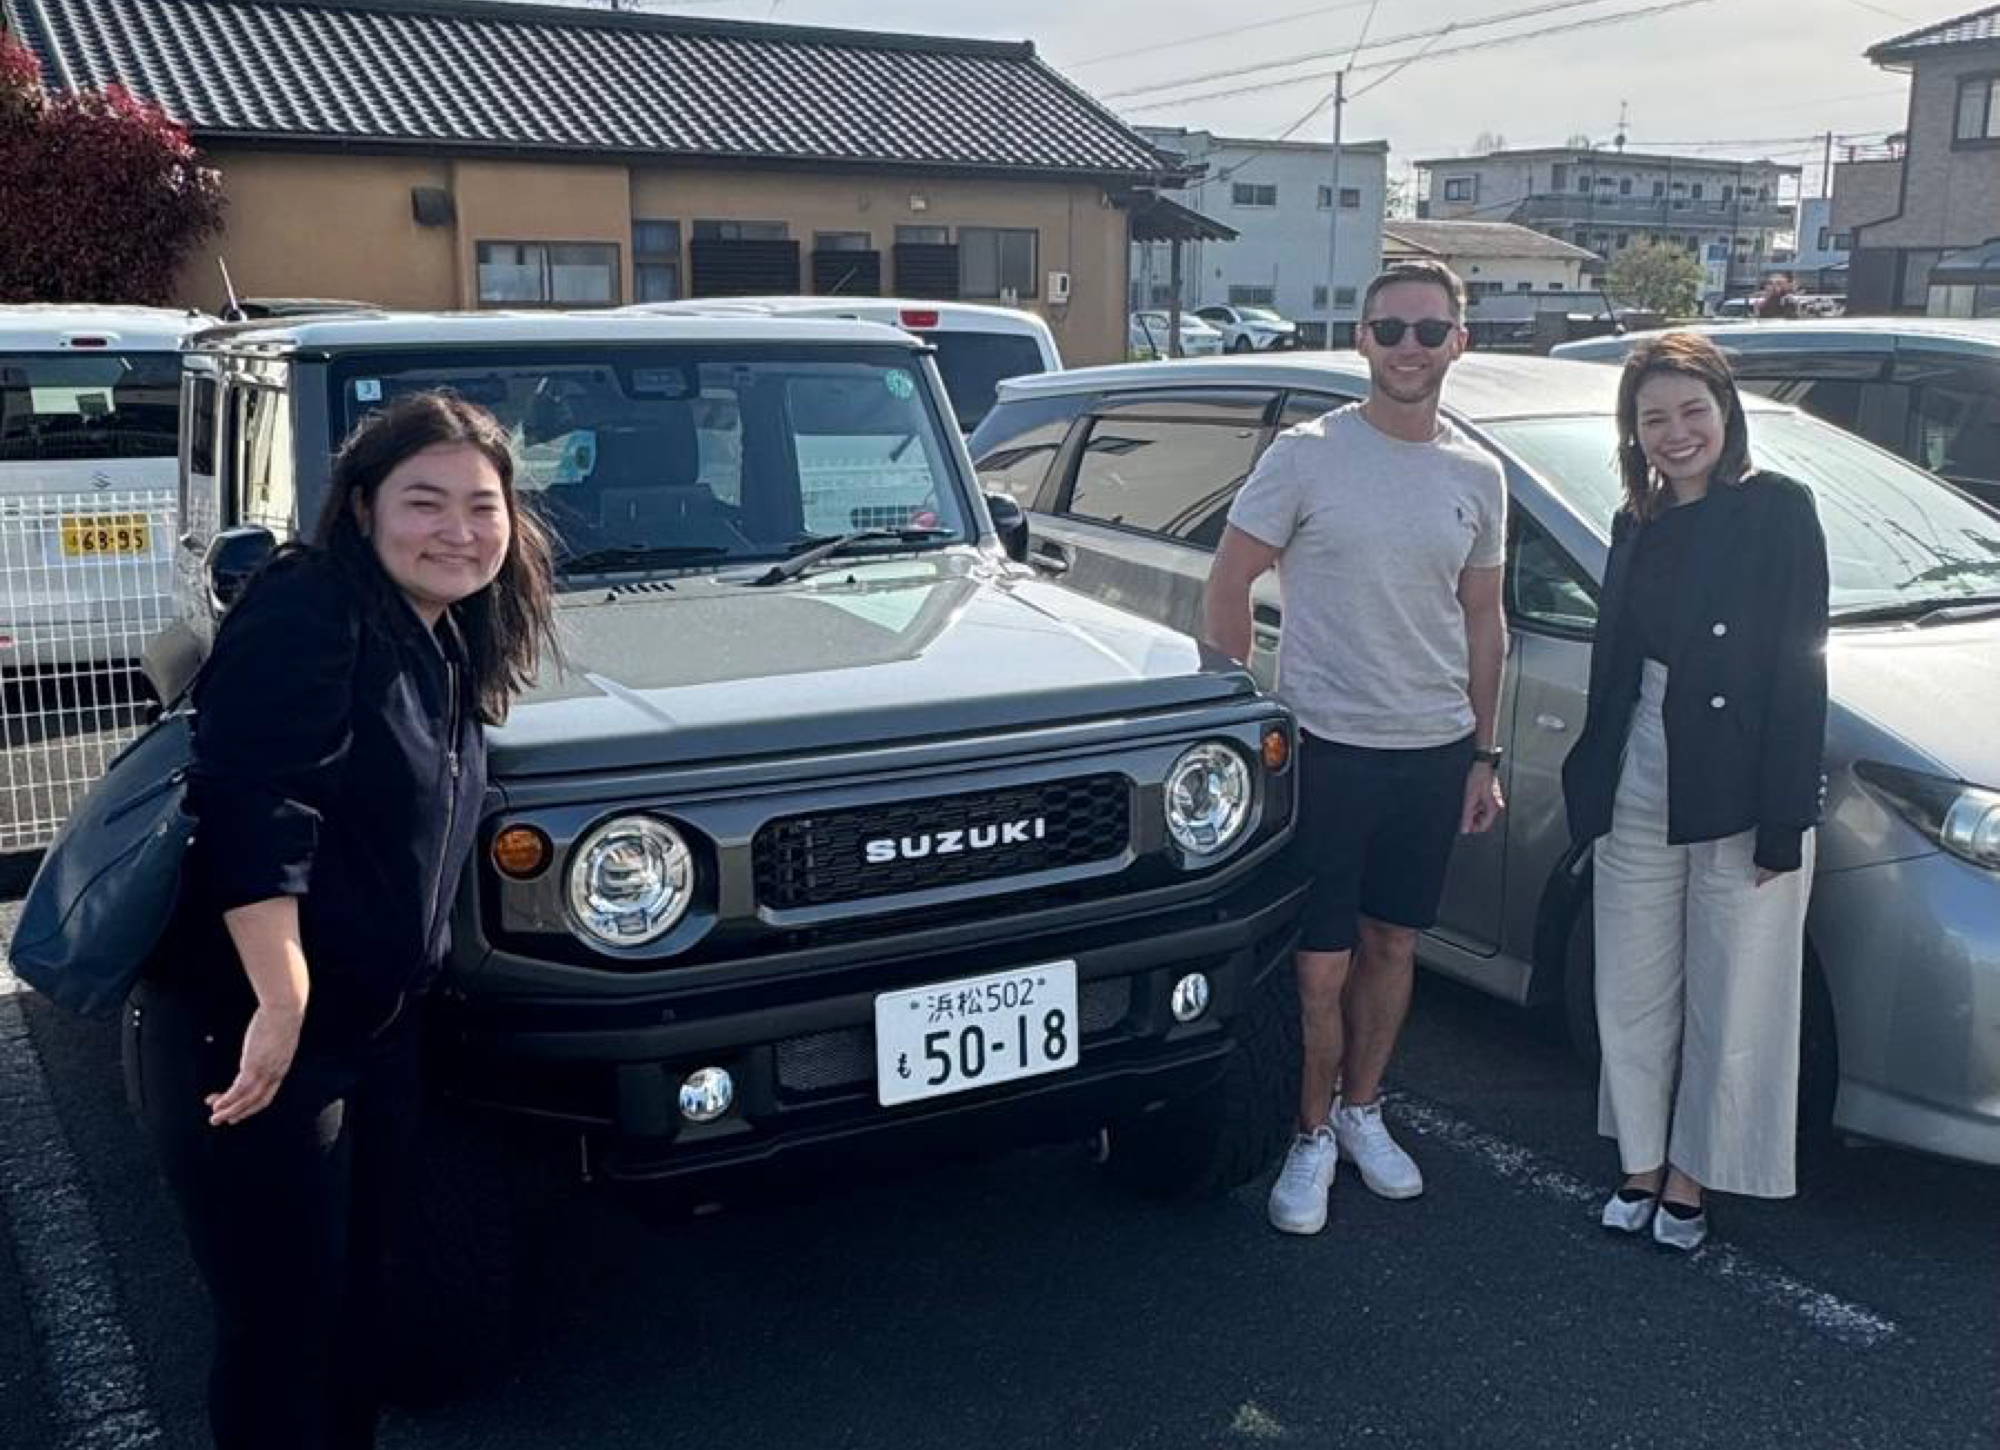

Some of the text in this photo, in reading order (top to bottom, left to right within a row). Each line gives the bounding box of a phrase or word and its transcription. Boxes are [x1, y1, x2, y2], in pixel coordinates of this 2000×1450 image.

[865, 817, 1046, 864] SUZUKI
[927, 977, 1034, 1024] 浜松502
[897, 1008, 1068, 1087] も 50-18
